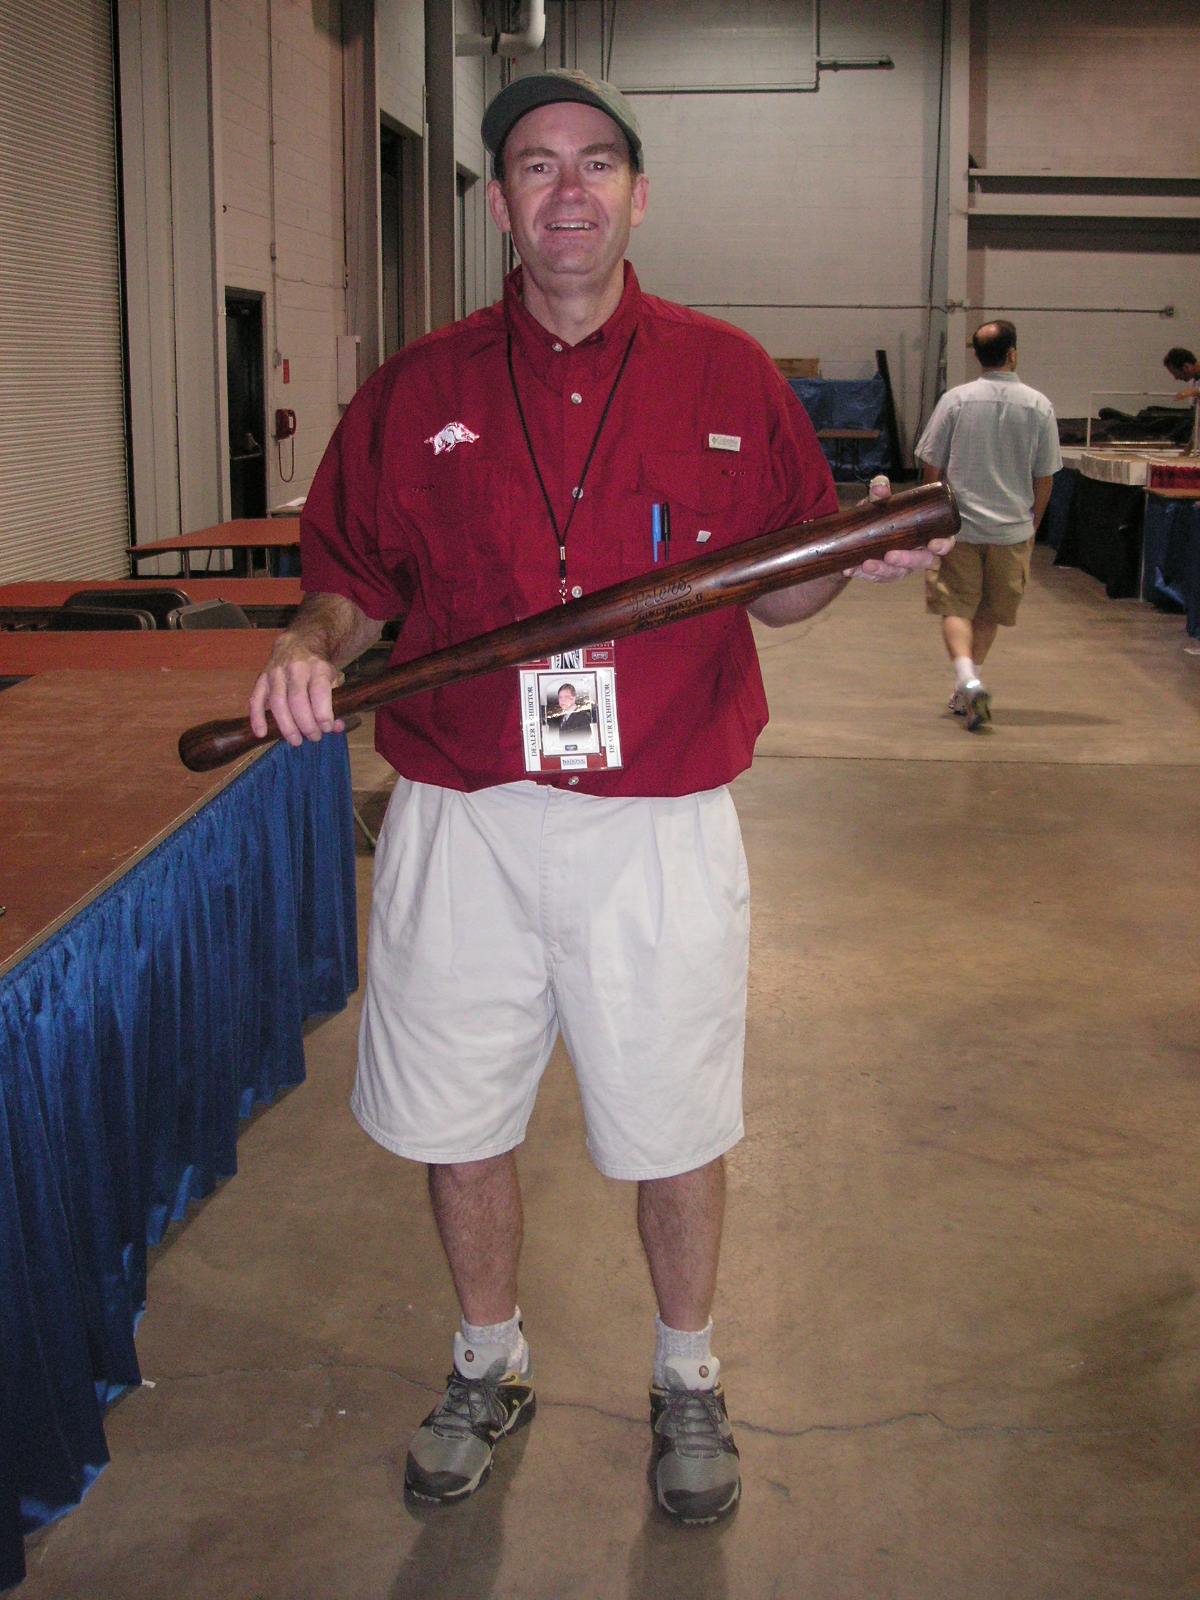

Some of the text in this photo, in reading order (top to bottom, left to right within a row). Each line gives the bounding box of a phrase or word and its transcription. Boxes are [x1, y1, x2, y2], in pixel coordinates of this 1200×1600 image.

[529, 728, 538, 757] DEALER
[604, 683, 615, 754] DEALER EXHIBITOR
